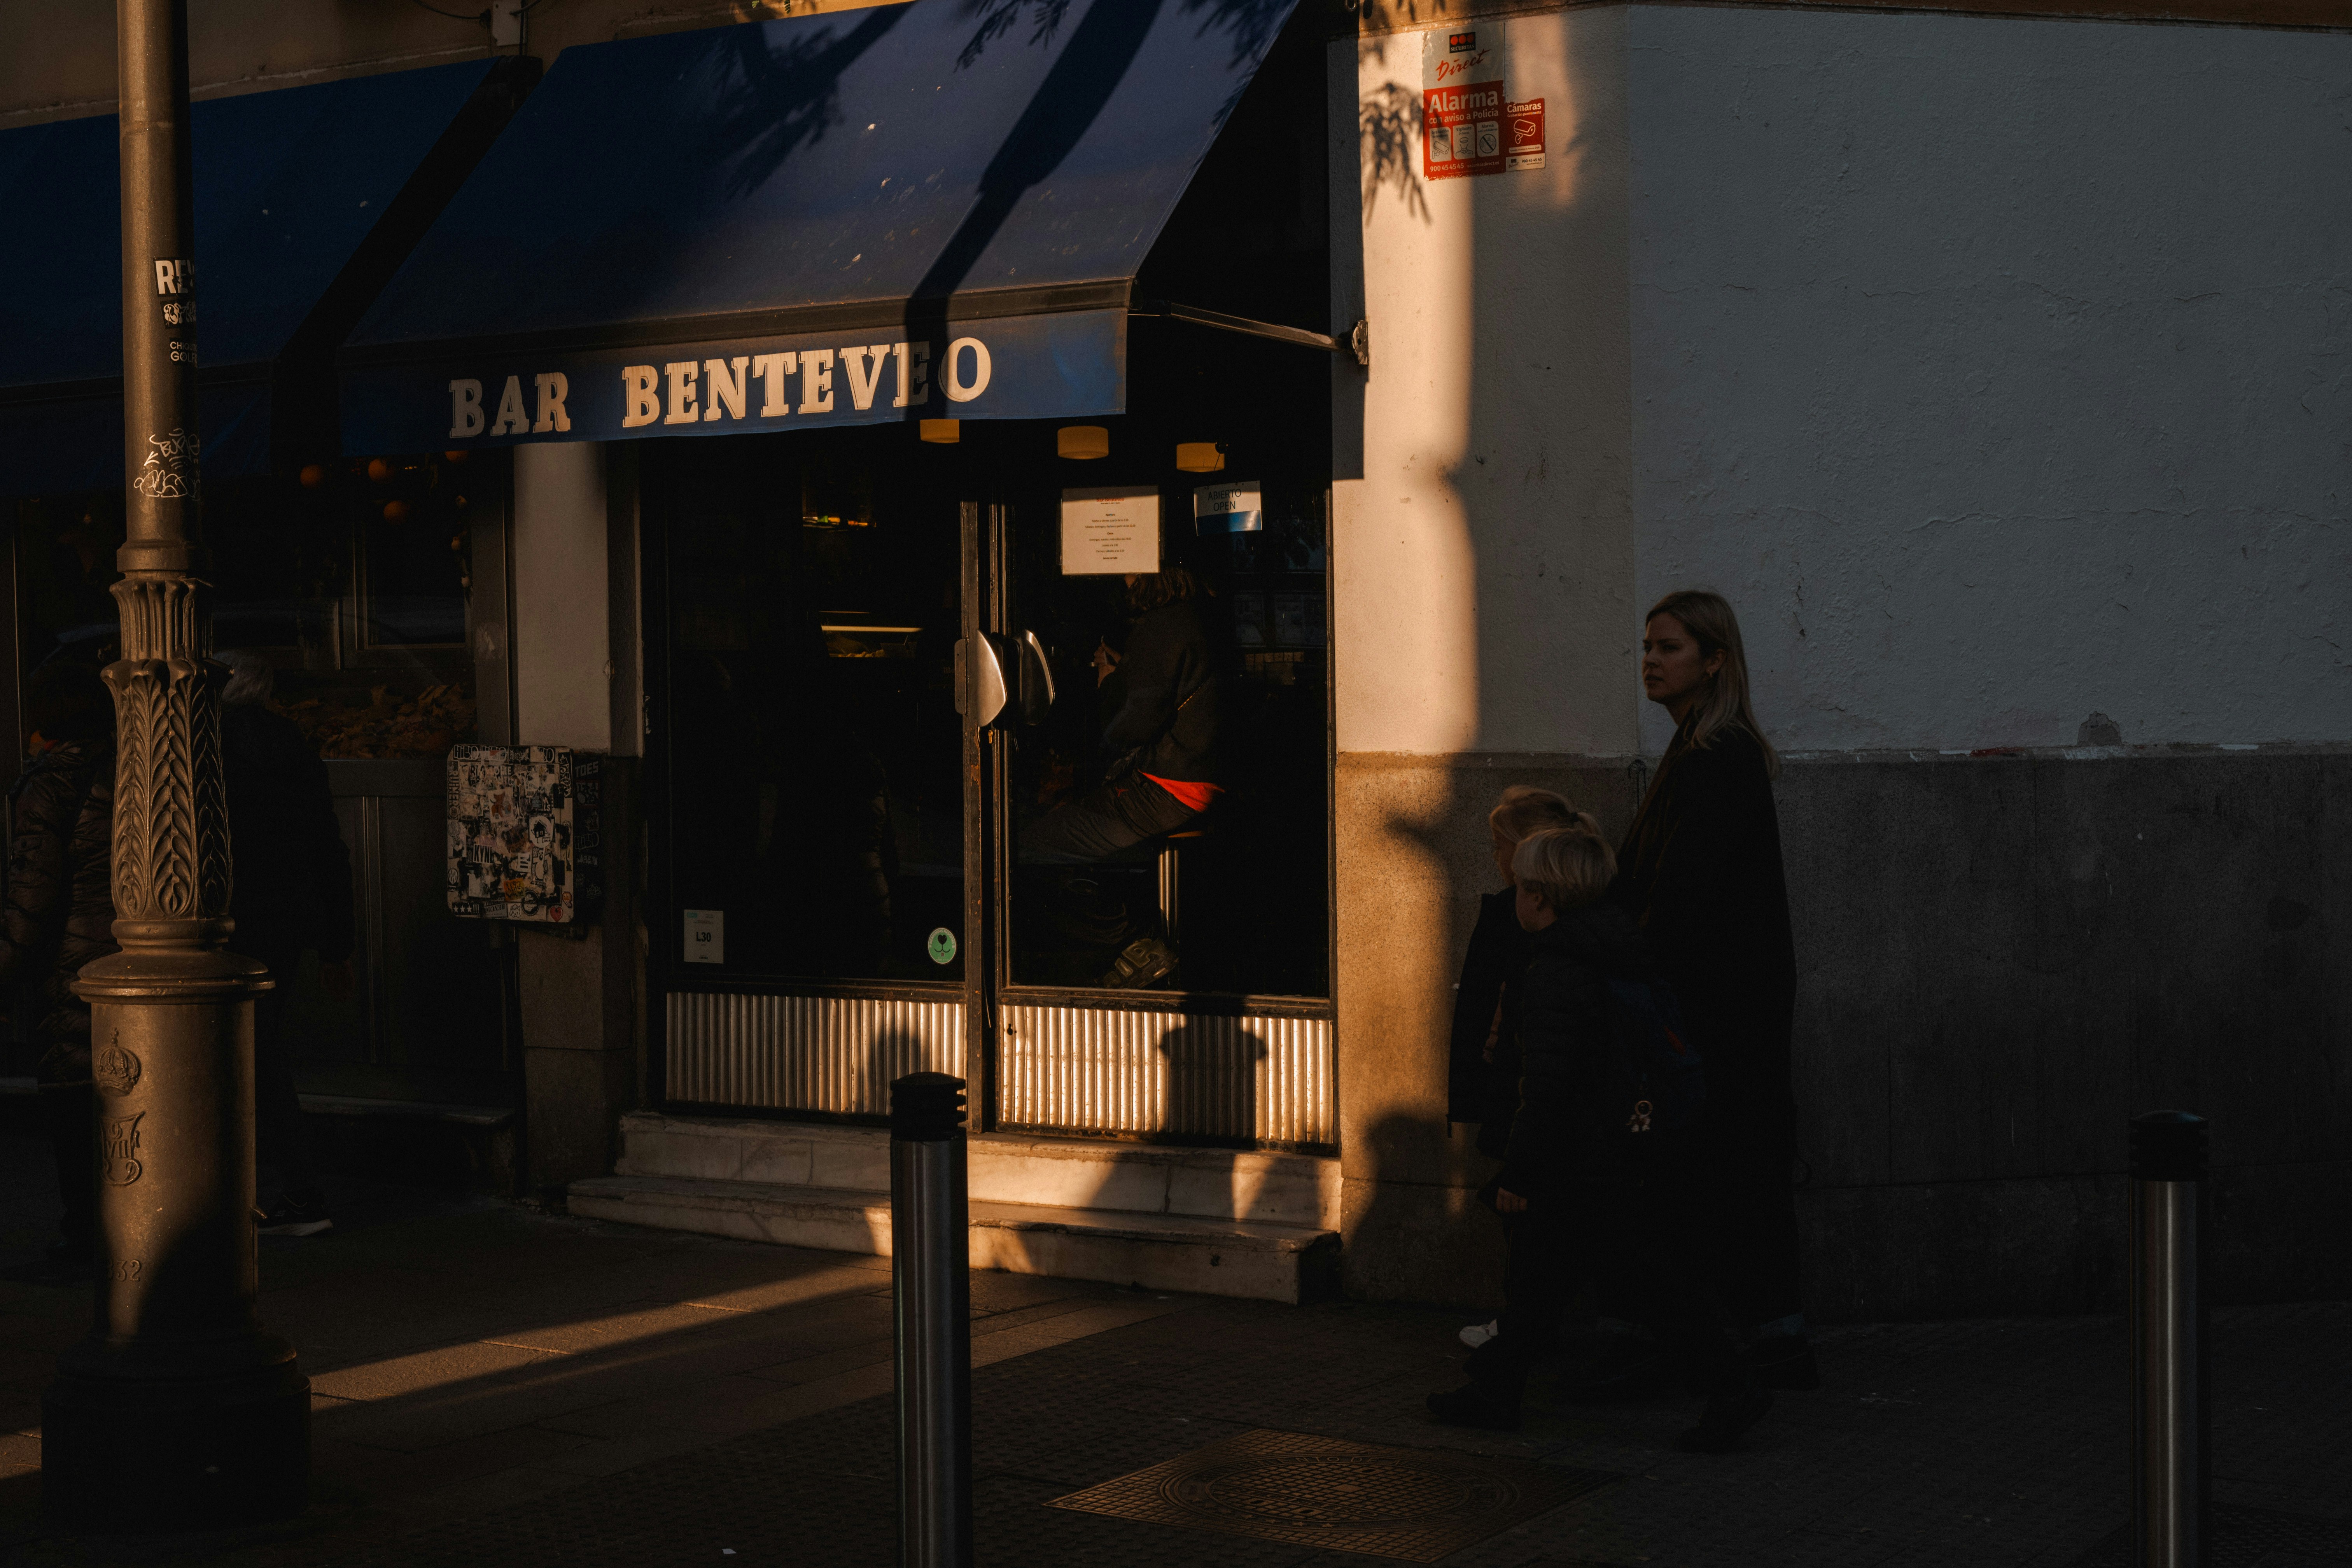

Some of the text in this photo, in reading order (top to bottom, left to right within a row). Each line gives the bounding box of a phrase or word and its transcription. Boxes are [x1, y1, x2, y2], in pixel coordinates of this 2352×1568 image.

[1435, 49, 1491, 81] Direct
[1429, 91, 1498, 113] Alarma
[1507, 103, 1541, 112] Cámaras
[1444, 113, 1464, 122] aviso
[1473, 108, 1498, 119] Policía
[449, 337, 991, 438] BAR BENTEVEO
[1208, 489, 1241, 500] ABIERTO
[1213, 501, 1235, 511] OPEN
[575, 761, 598, 777] TOES
[696, 932, 711, 942] L30
